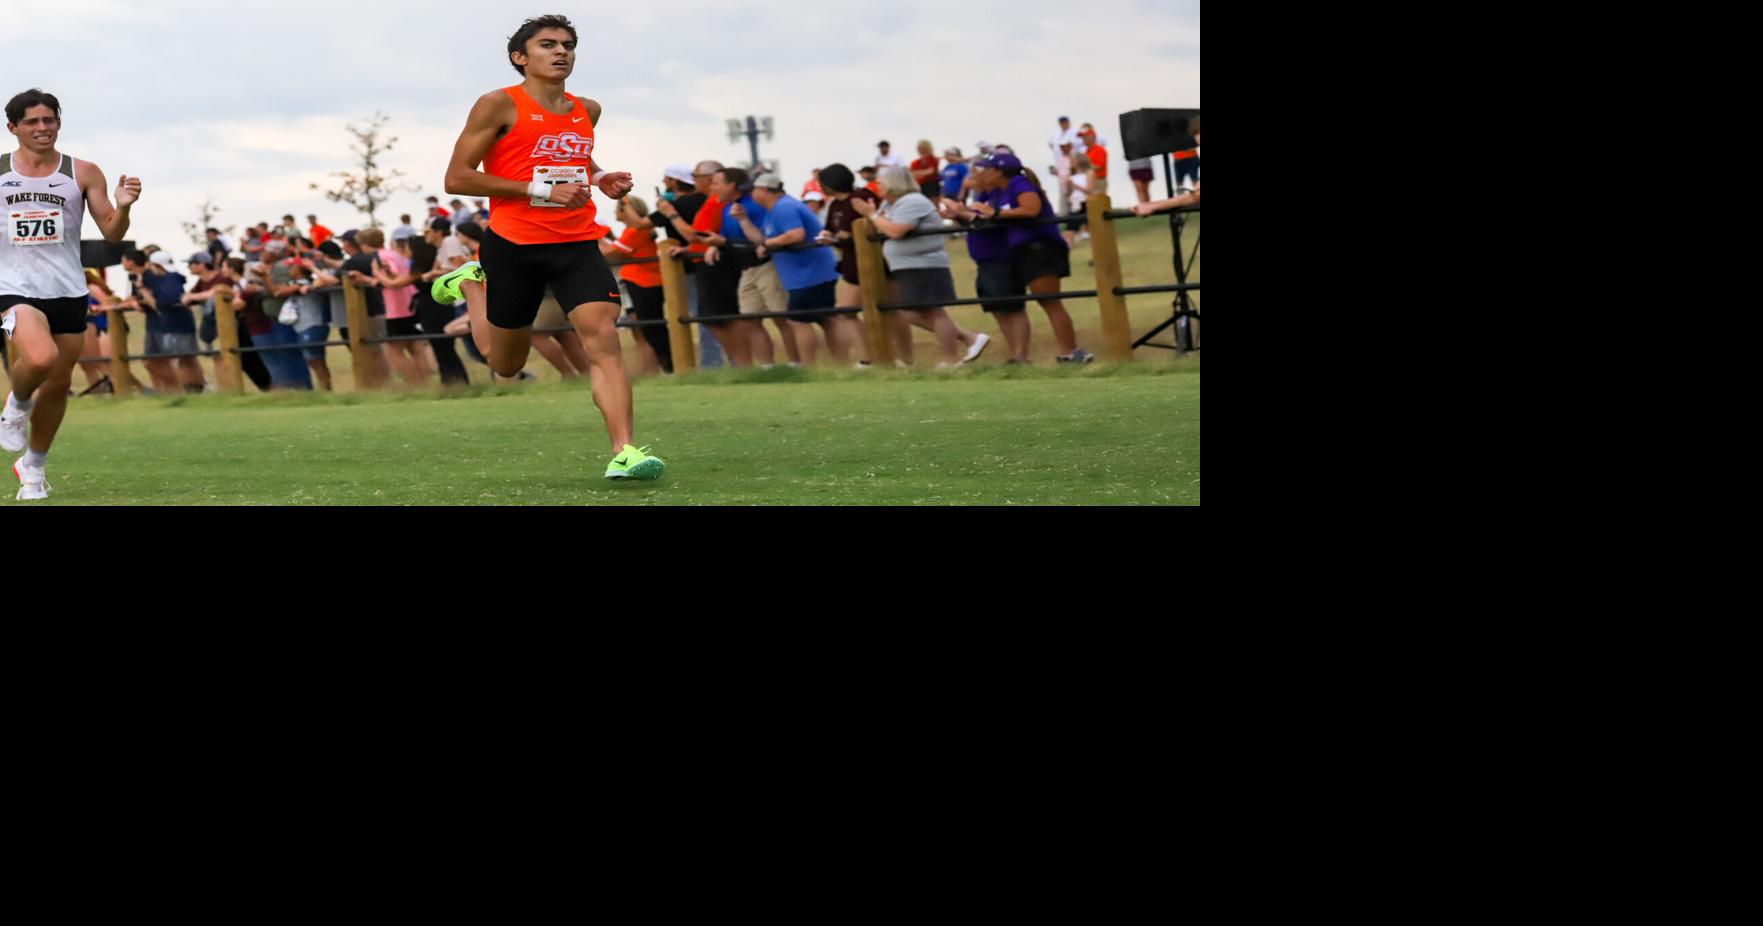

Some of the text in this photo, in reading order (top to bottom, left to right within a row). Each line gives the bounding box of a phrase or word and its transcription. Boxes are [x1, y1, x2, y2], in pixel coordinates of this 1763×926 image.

[5, 192, 66, 207] WAKE FOREST
[16, 219, 56, 237] 576
